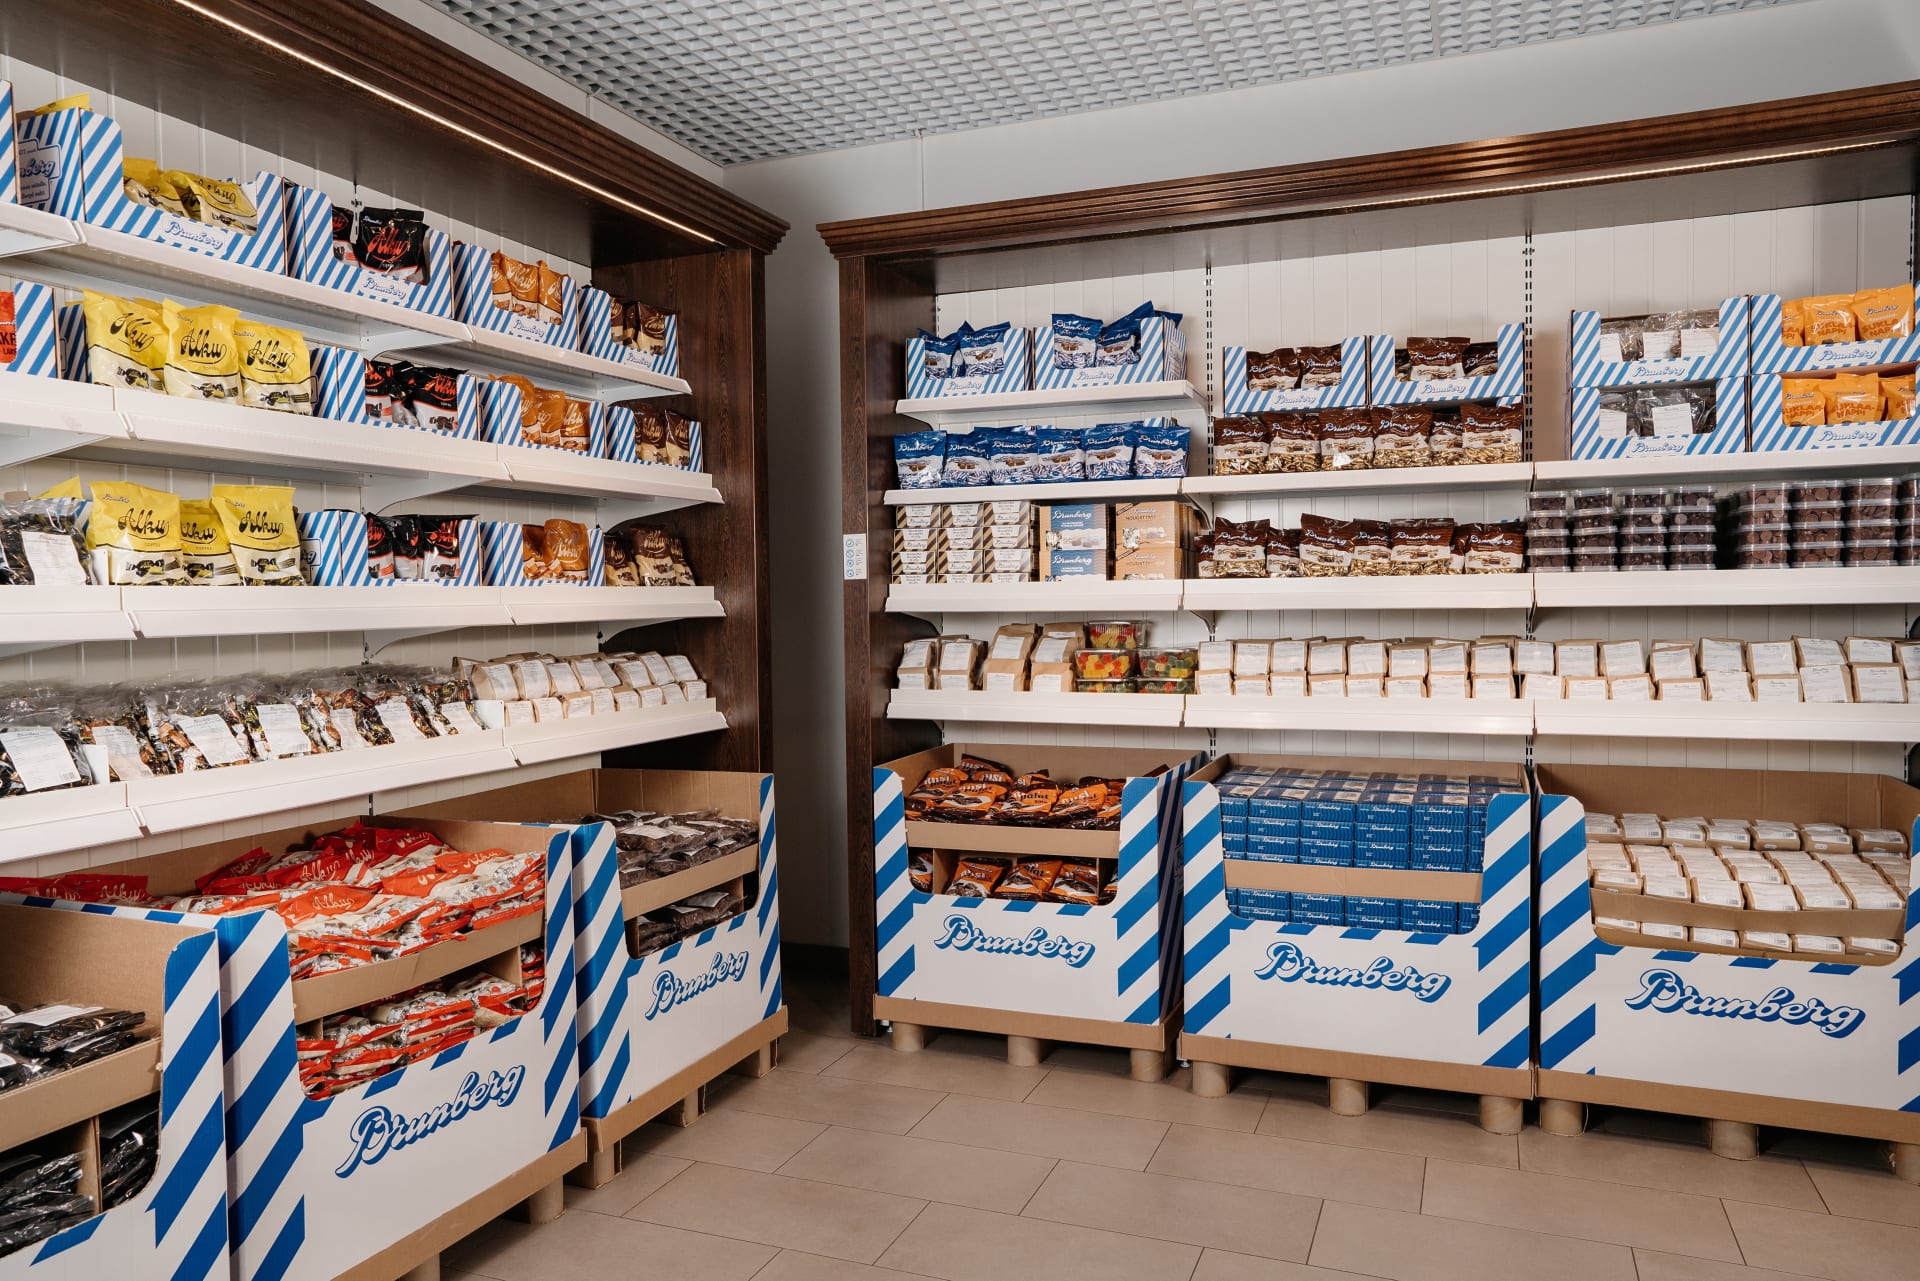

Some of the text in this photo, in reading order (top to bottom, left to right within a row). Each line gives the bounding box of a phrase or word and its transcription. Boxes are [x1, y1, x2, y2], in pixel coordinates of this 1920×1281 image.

[180, 328, 227, 364] Alku
[247, 340, 296, 373] Alku
[118, 508, 169, 540] Alku
[239, 511, 284, 540] Alku
[1052, 510, 1093, 519] Brunberg
[1052, 555, 1093, 564] Brunberg
[934, 914, 1096, 968] Brunberg
[645, 950, 749, 1021] Brunberg
[1254, 941, 1452, 1003] Brunberg
[1625, 968, 1866, 1038] Brunberg
[335, 1065, 526, 1178] Brunberg
